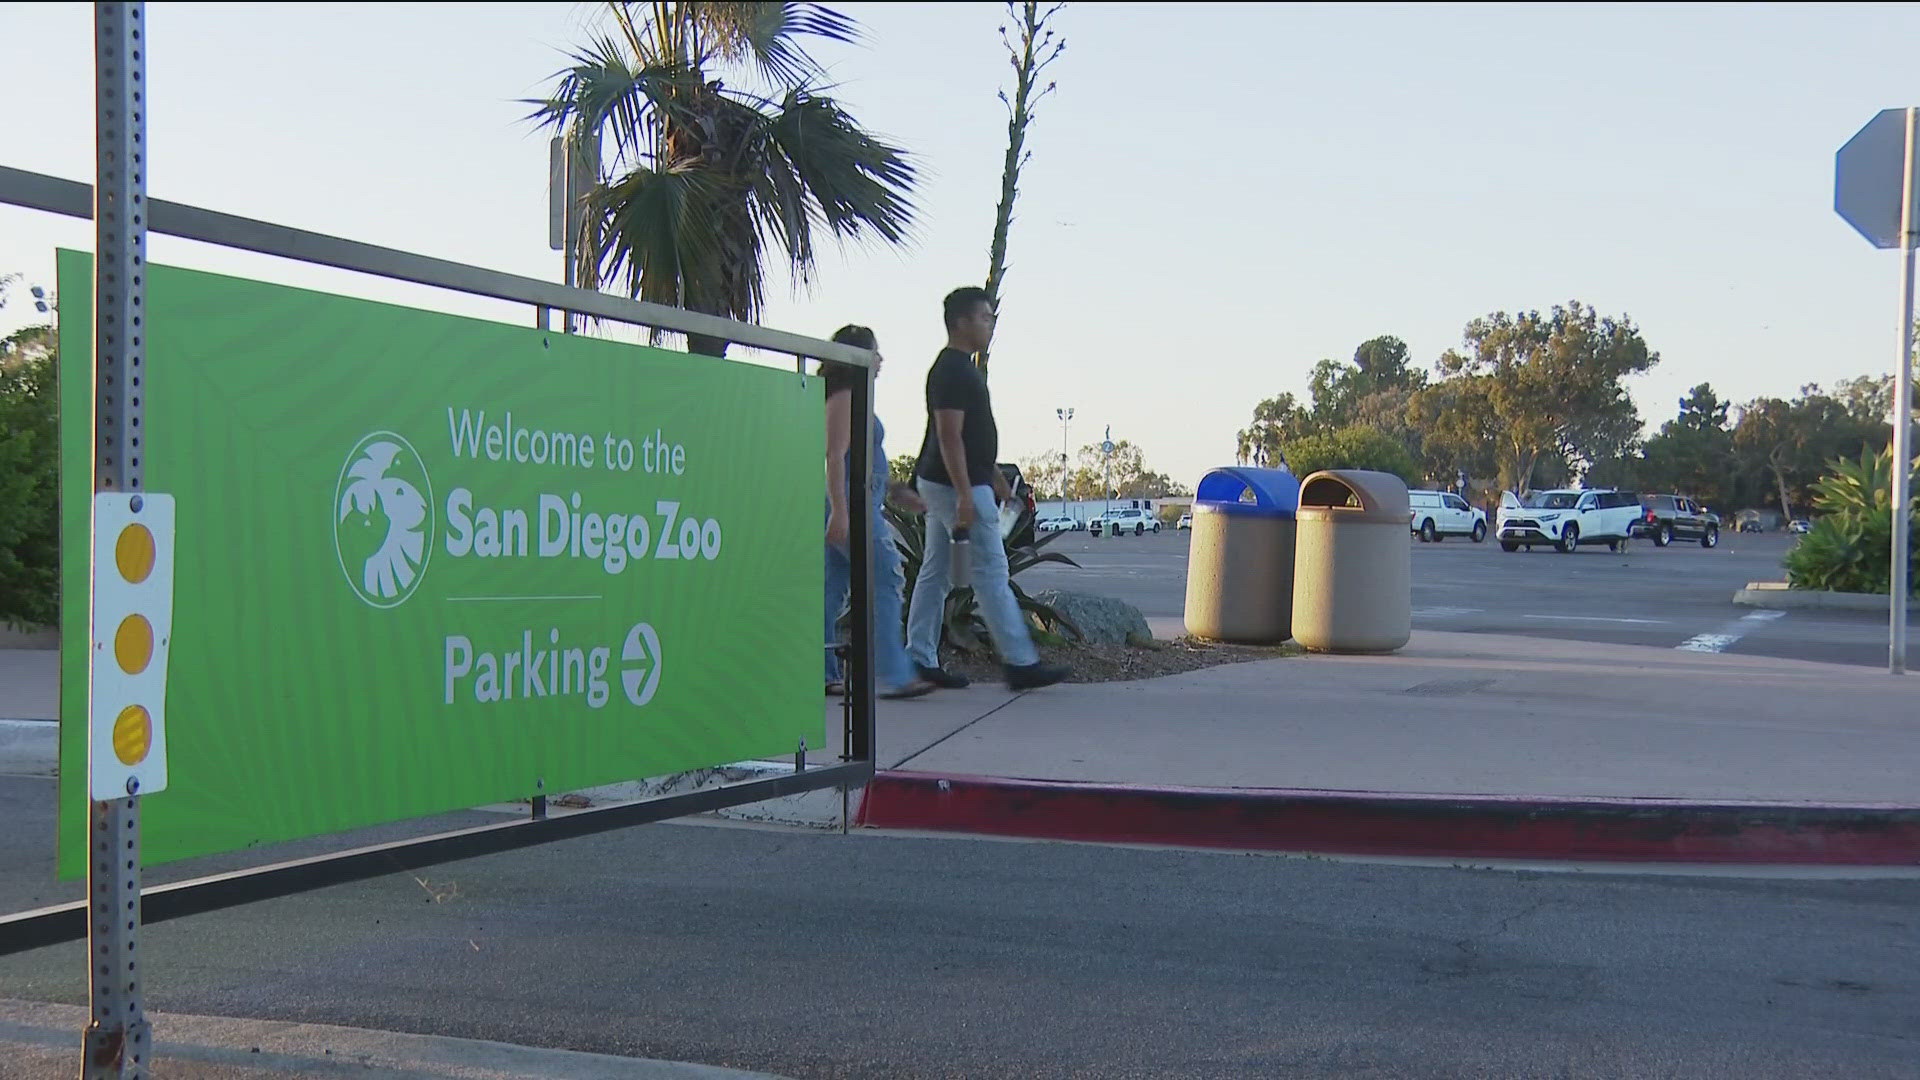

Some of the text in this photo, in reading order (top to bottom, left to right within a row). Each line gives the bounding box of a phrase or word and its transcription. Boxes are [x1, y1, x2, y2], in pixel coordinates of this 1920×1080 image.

[448, 406, 686, 476] Welcome to the
[445, 487, 722, 574] San Diego Zoo
[445, 627, 611, 708] Parking
